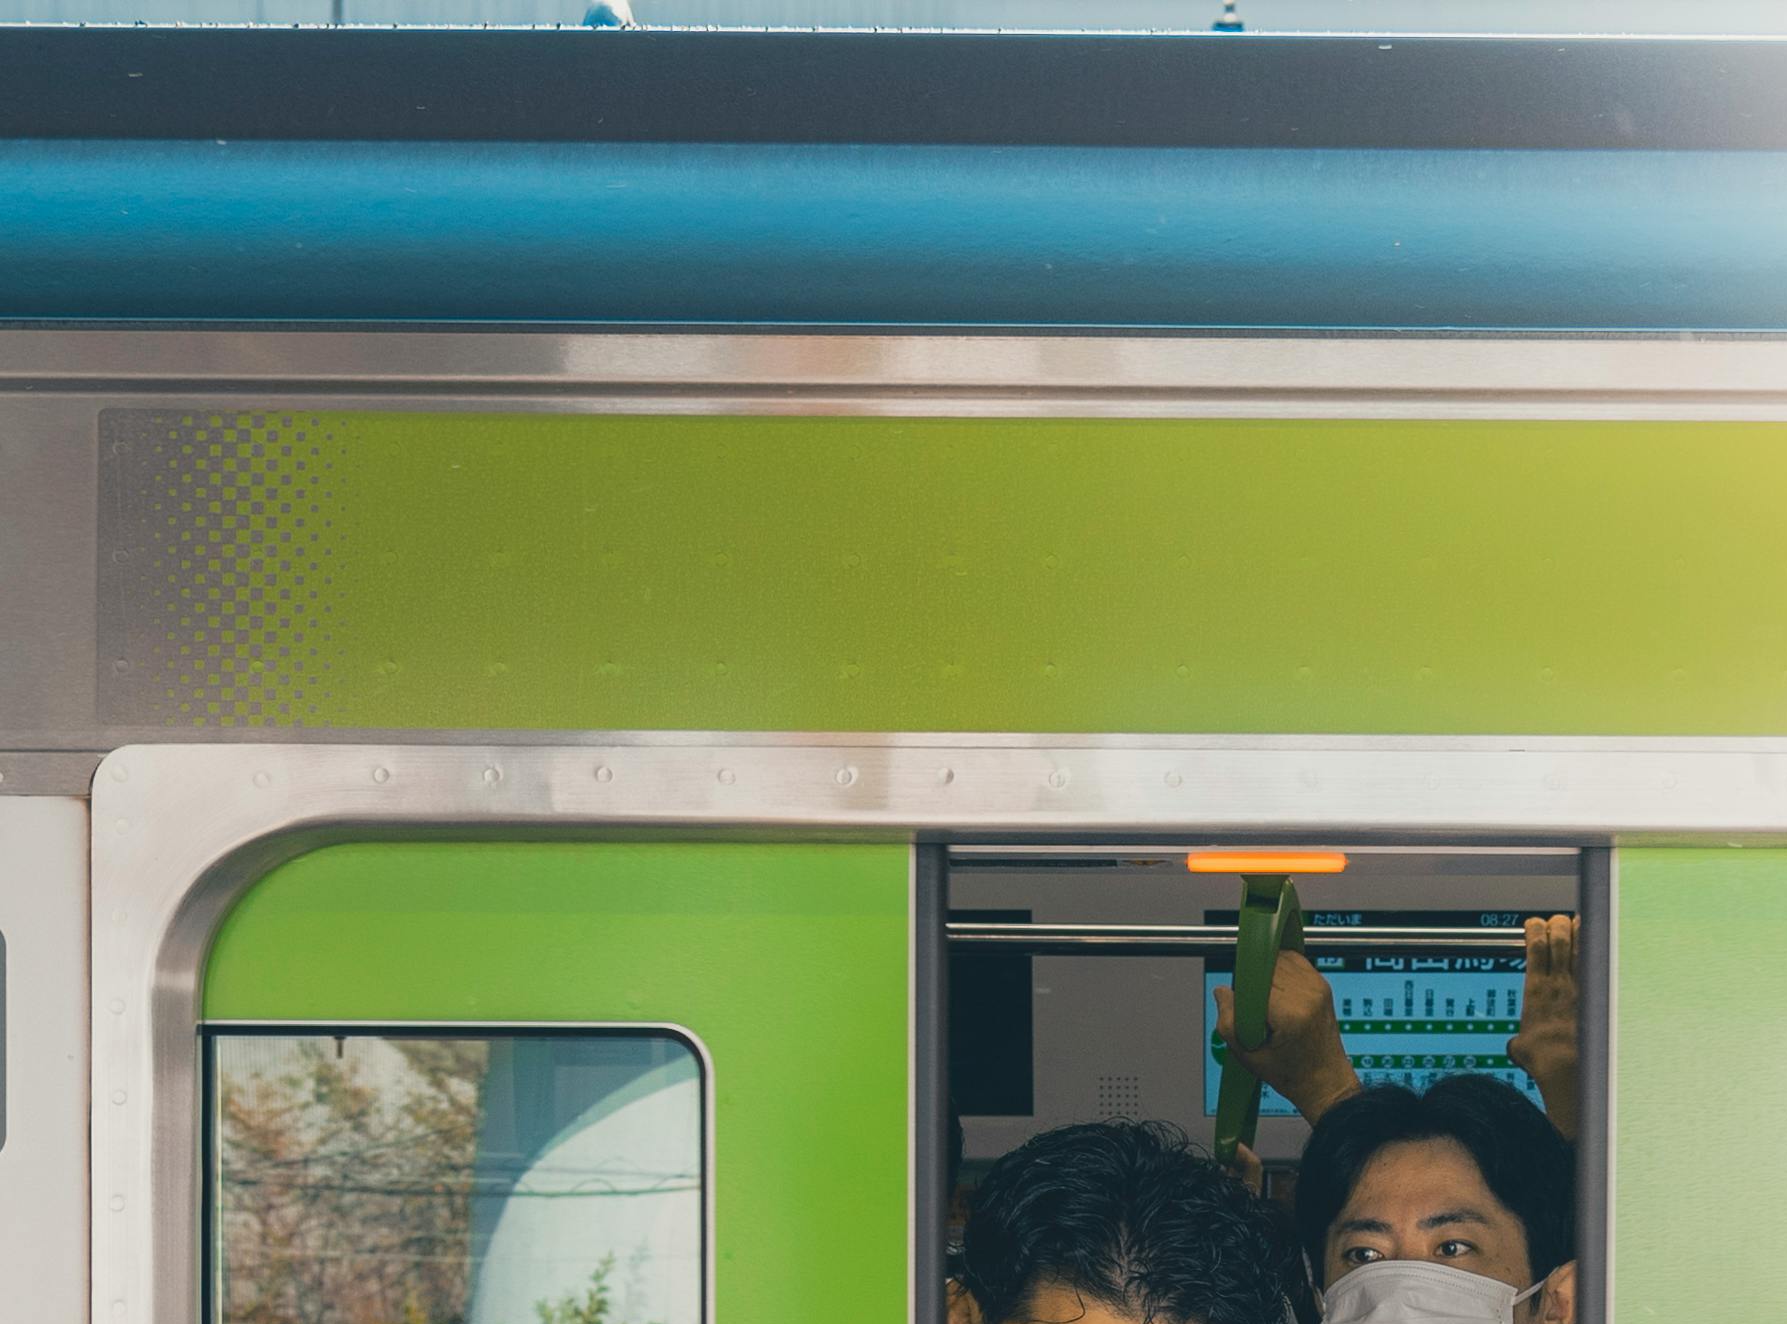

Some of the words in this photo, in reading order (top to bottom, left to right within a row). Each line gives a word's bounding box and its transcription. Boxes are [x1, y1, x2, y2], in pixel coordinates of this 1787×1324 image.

[1312, 913, 1363, 926] ただいま
[1479, 913, 1520, 927] 08:27
